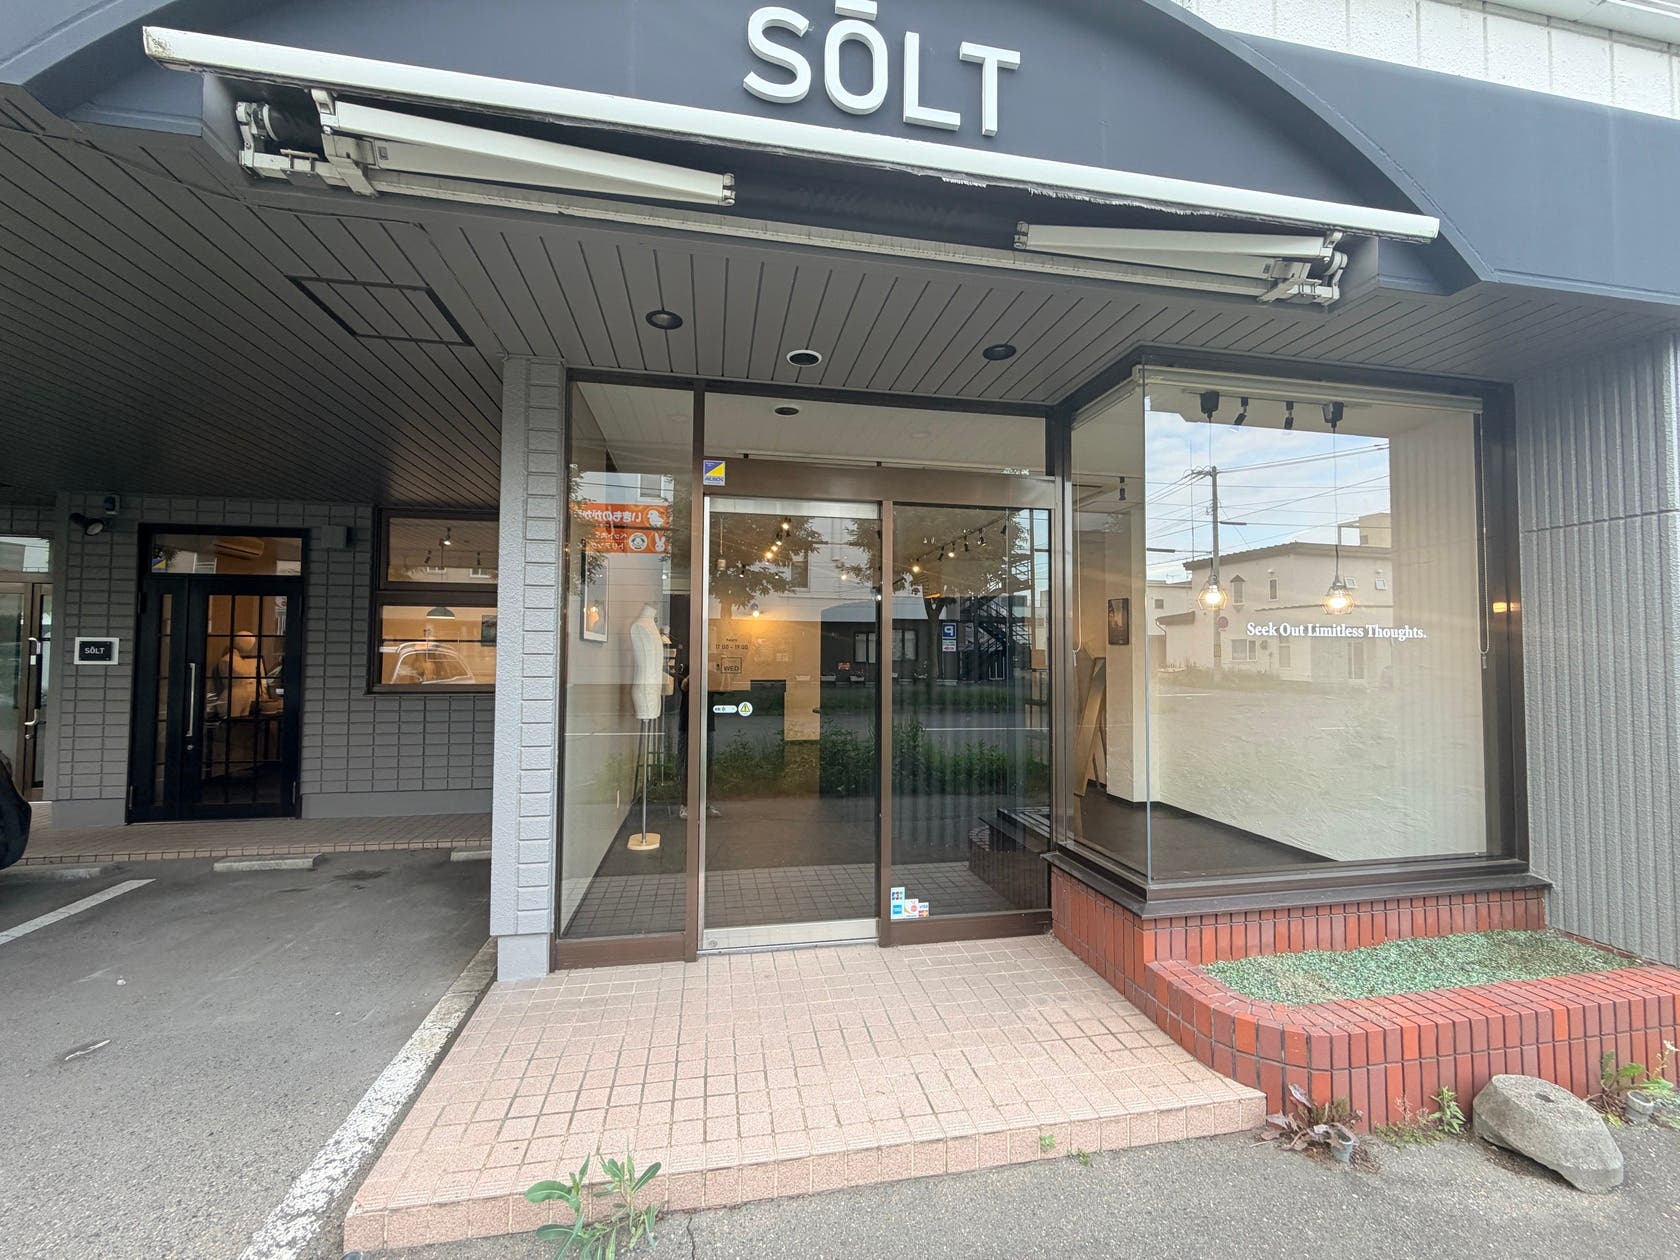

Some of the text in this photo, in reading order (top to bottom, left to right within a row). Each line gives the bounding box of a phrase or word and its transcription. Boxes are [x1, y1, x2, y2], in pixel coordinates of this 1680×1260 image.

[1247, 622, 1428, 641] Seek Out Limitless Thoughts.
